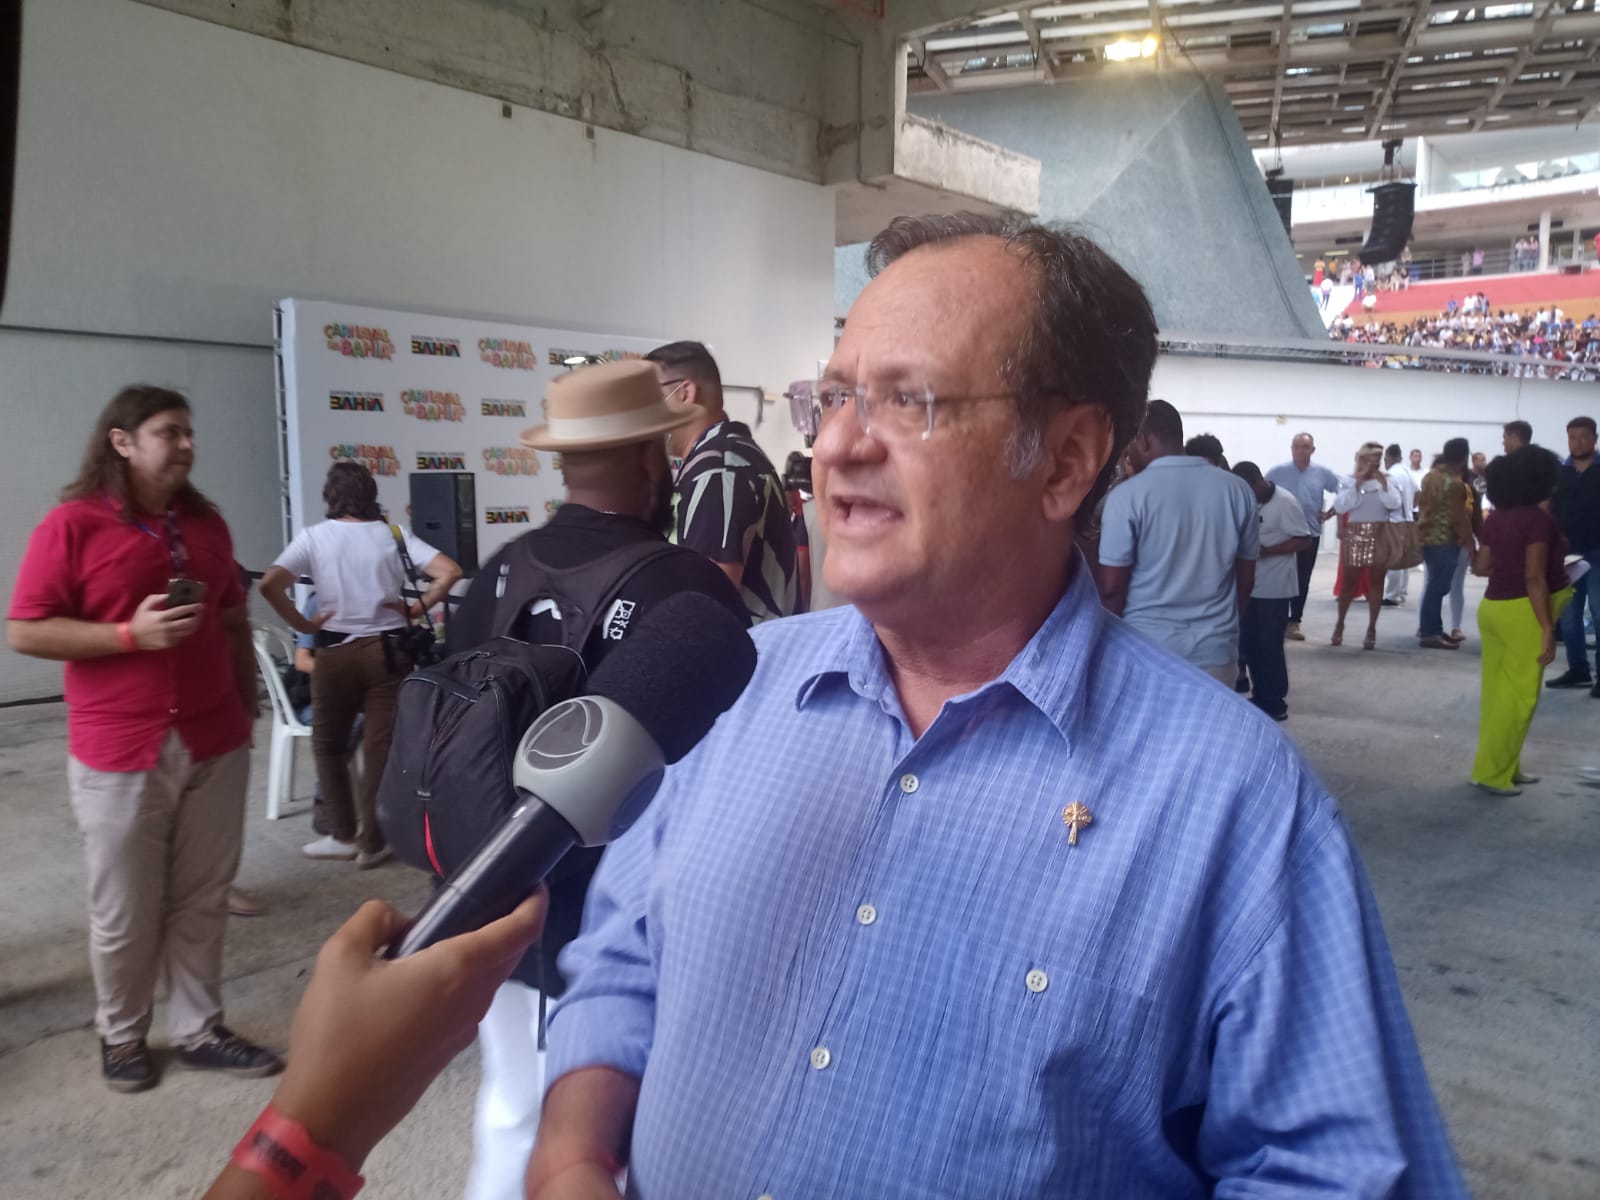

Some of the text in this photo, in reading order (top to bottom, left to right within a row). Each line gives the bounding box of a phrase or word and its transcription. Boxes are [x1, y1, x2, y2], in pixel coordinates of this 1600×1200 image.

[341, 337, 393, 360] BAHIA
[411, 340, 461, 357] BAHIA
[491, 351, 535, 371] BAHIA
[329, 395, 384, 412] BAHIA
[481, 403, 526, 417] BAHIA
[416, 403, 463, 422] BAHIA
[416, 456, 465, 470] BAHIA
[486, 511, 529, 524] BAHIA
